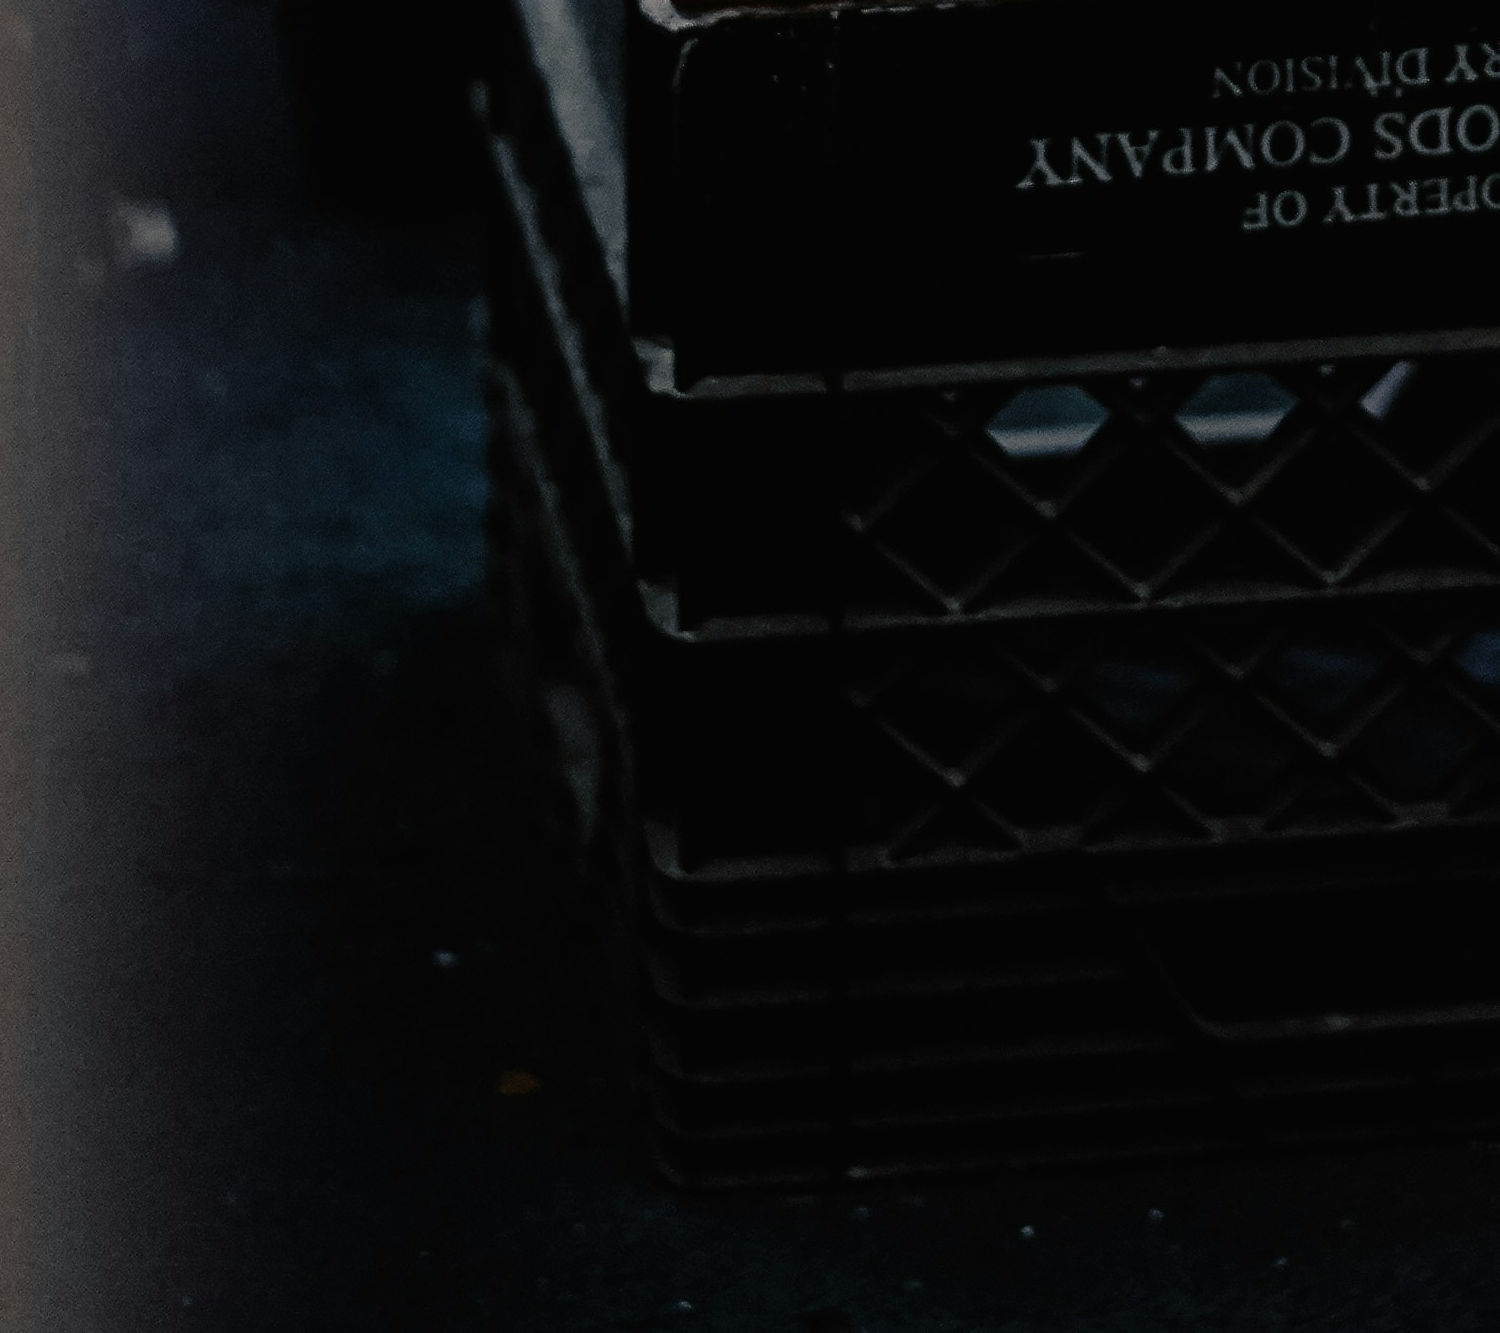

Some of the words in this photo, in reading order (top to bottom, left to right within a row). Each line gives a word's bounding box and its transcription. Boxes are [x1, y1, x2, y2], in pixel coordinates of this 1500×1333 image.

[1213, 46, 1431, 98] DIVISION
[1015, 117, 1352, 191] COMPANY
[1241, 190, 1309, 232] OF
